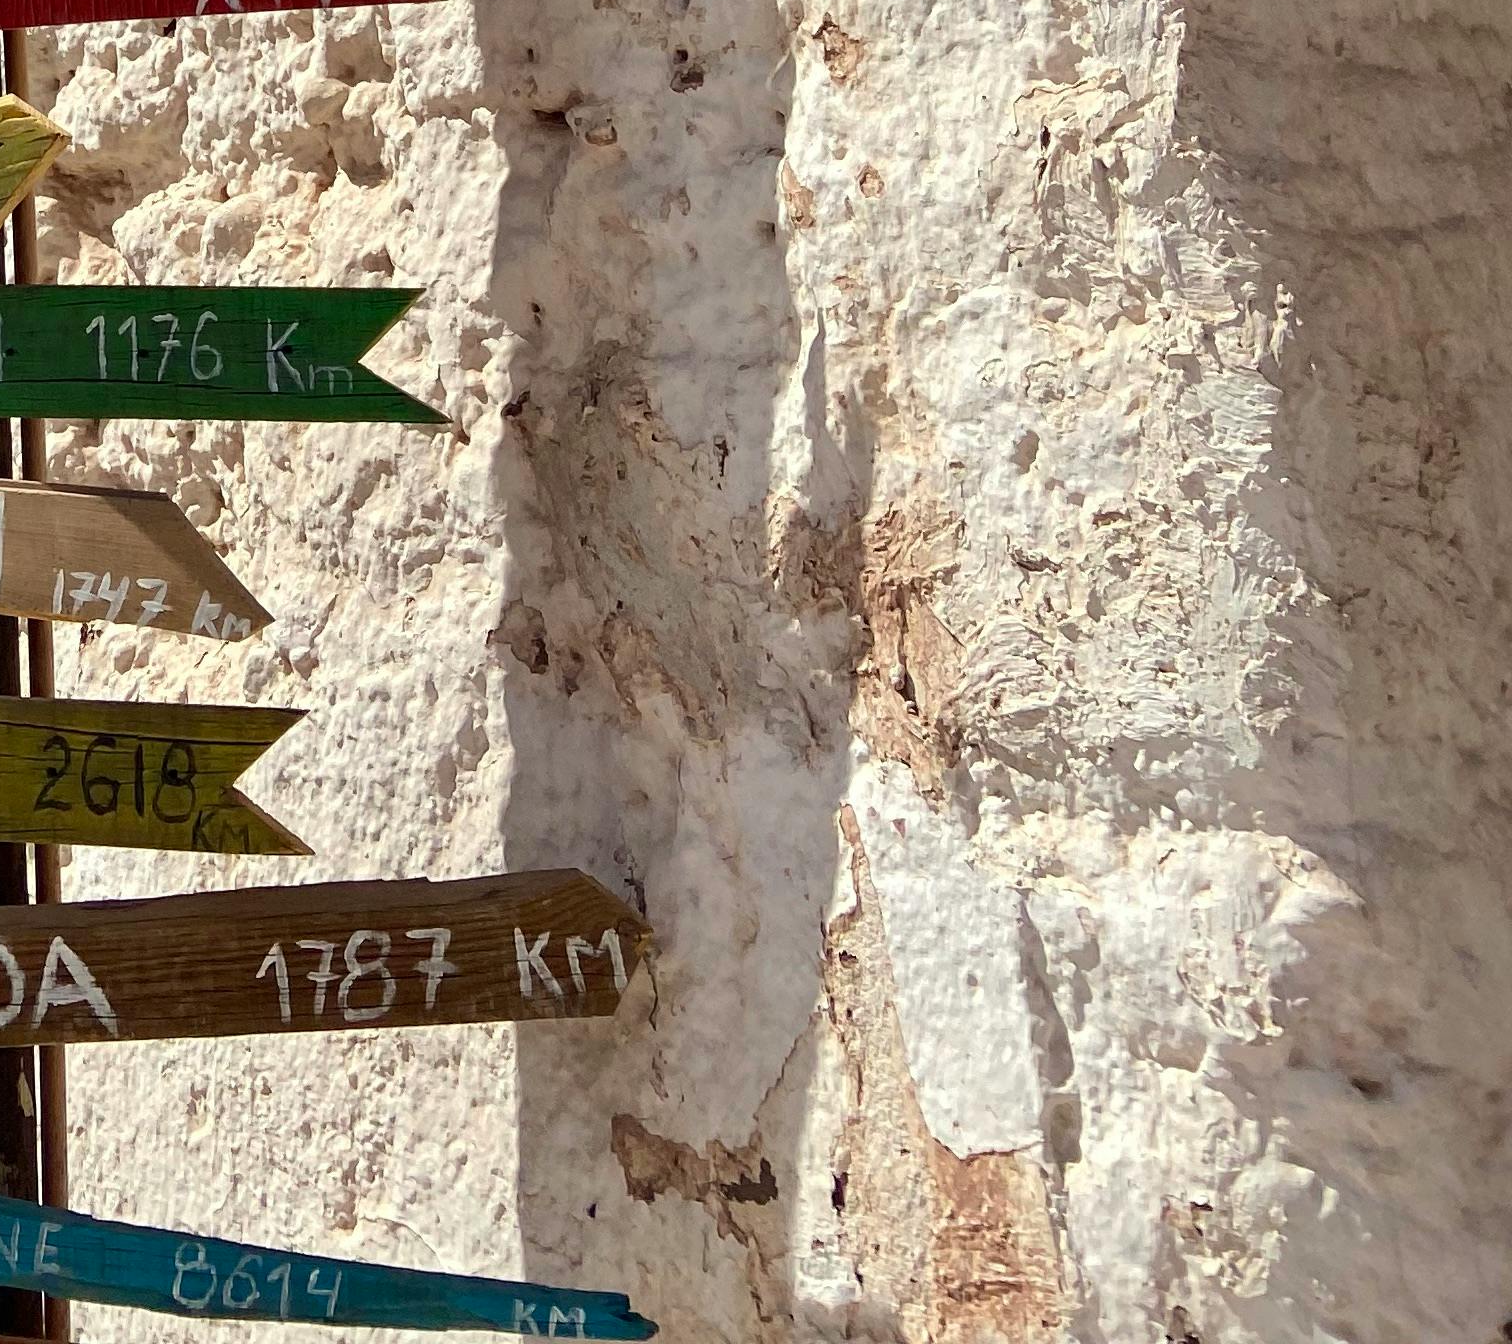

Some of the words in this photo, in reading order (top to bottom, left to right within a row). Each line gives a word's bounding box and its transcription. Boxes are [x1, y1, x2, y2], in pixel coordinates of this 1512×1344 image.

[85, 311, 224, 382] 1176
[52, 567, 176, 628] 1747
[33, 734, 198, 824] 2618
[255, 927, 458, 1024] 1787
[513, 926, 628, 1000] KM
[171, 1241, 343, 1320] 8614
[512, 1297, 587, 1340] KM
